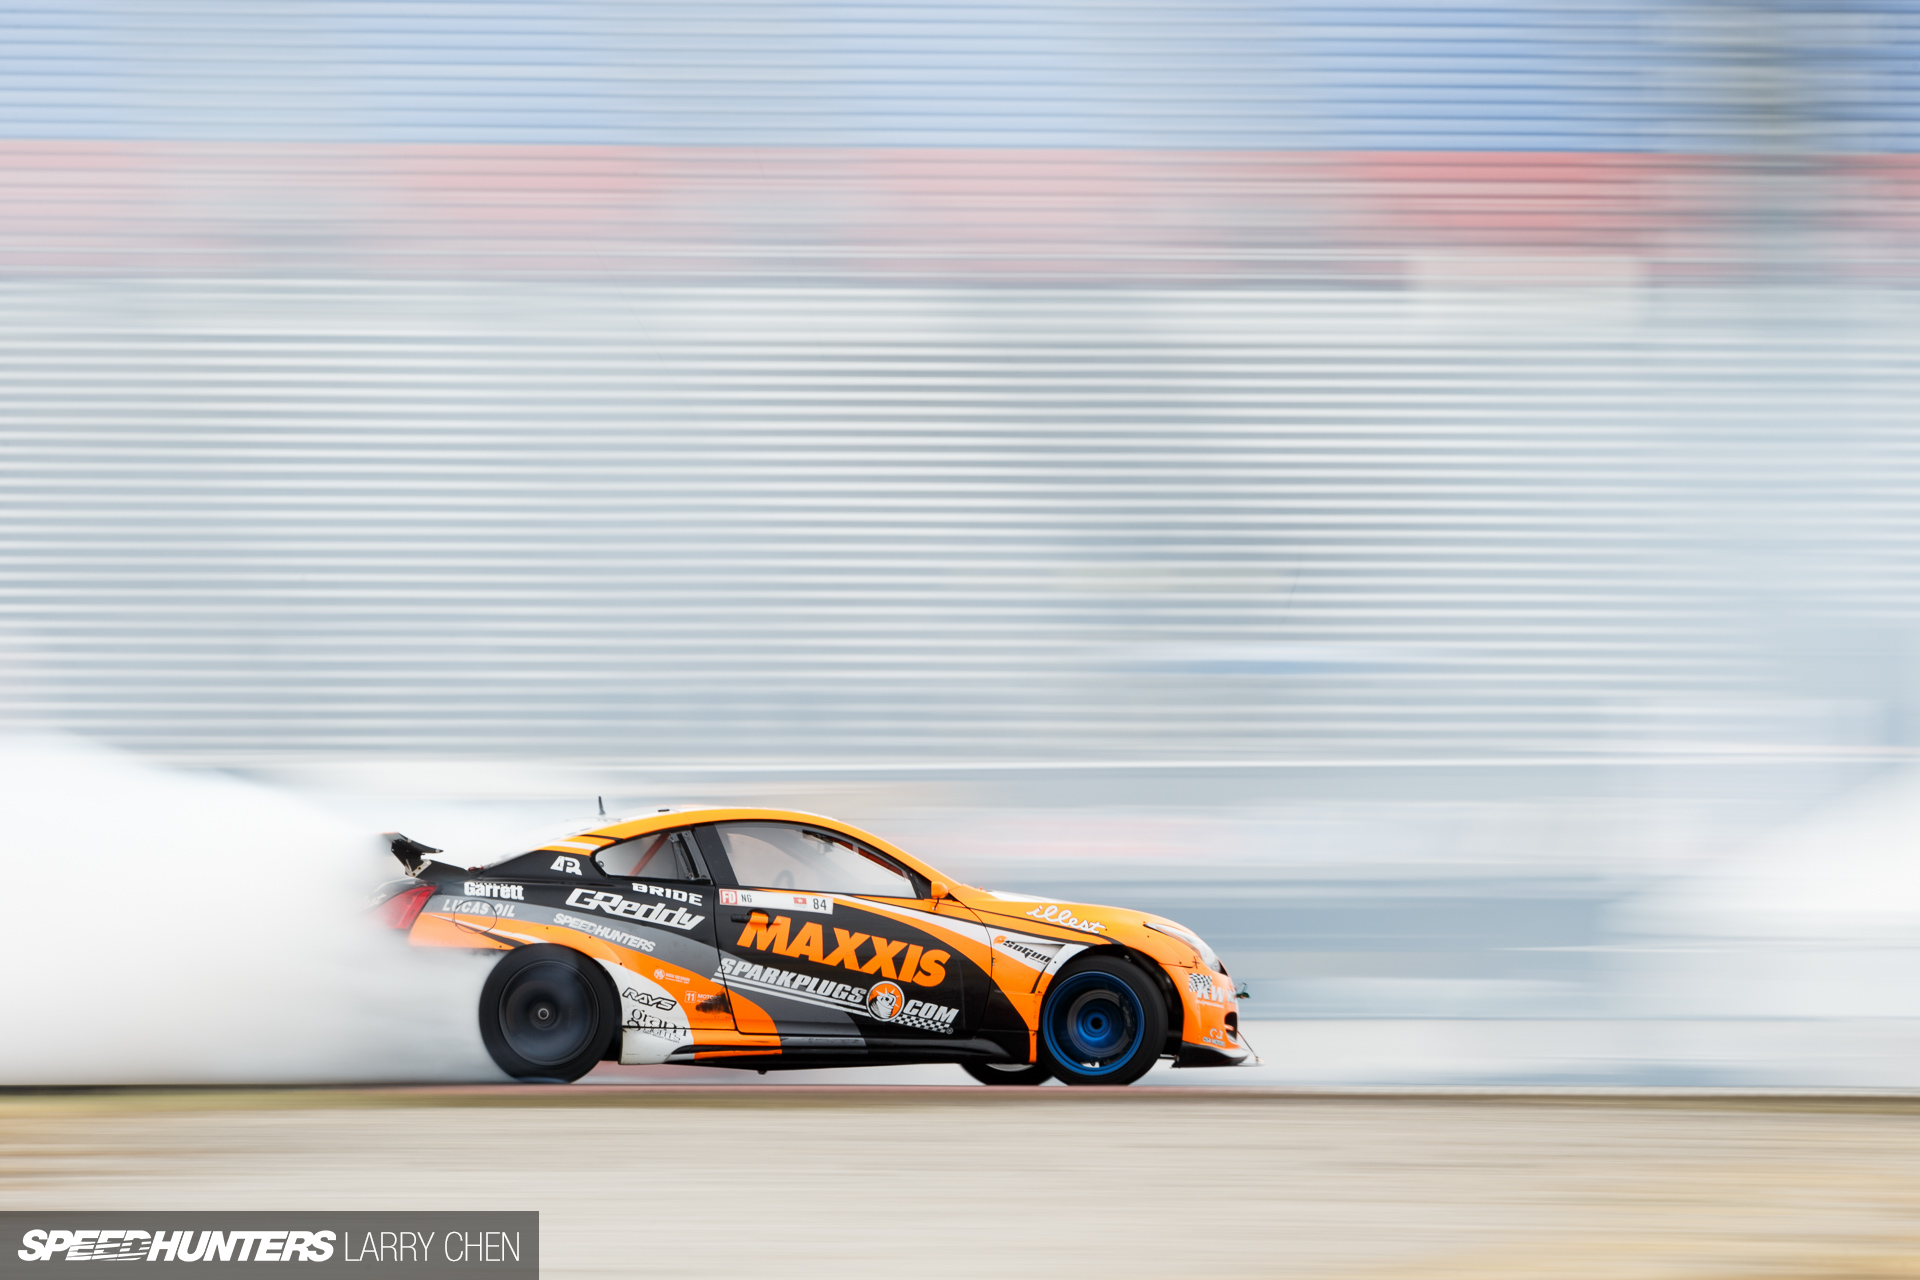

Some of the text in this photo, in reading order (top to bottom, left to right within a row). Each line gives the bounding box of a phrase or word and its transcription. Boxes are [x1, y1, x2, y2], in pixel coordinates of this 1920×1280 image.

[464, 882, 524, 901] Garrett
[631, 882, 703, 907] BRIDE
[741, 894, 753, 903] NG
[812, 898, 827, 911] 84
[442, 899, 516, 918] LUCAS OIL
[565, 888, 706, 931] GReddy
[1025, 904, 1106, 935] illest
[553, 912, 657, 953] SPEEDHUNTERS
[736, 913, 951, 988] MAXXIS
[718, 957, 868, 1004] SPARKPLUGS
[622, 987, 677, 1011] RAYS
